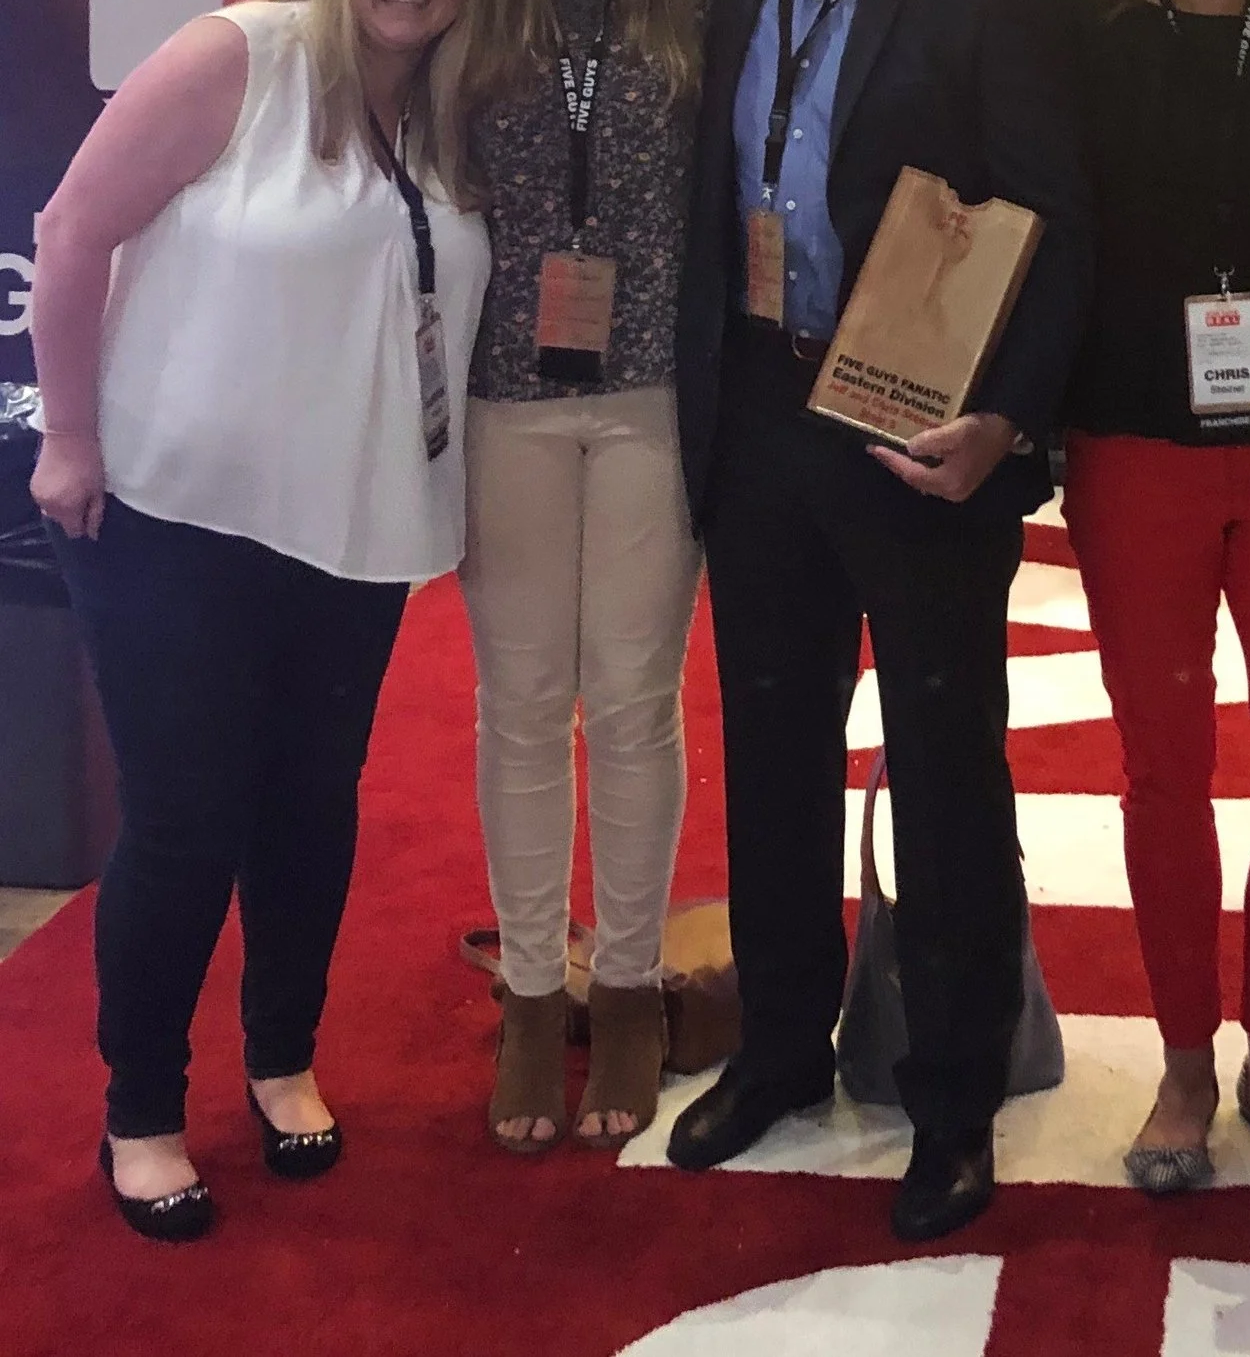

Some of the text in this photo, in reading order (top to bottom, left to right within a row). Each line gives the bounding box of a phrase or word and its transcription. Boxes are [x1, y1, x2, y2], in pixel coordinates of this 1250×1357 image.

[559, 57, 576, 89] FIVE
[576, 58, 598, 132] FIVE GUYS
[832, 367, 885, 395] Eastern
[890, 387, 946, 418] Division
[838, 354, 950, 404] FIVE GUYS FANATIC
[1204, 366, 1250, 382] CHRIS
